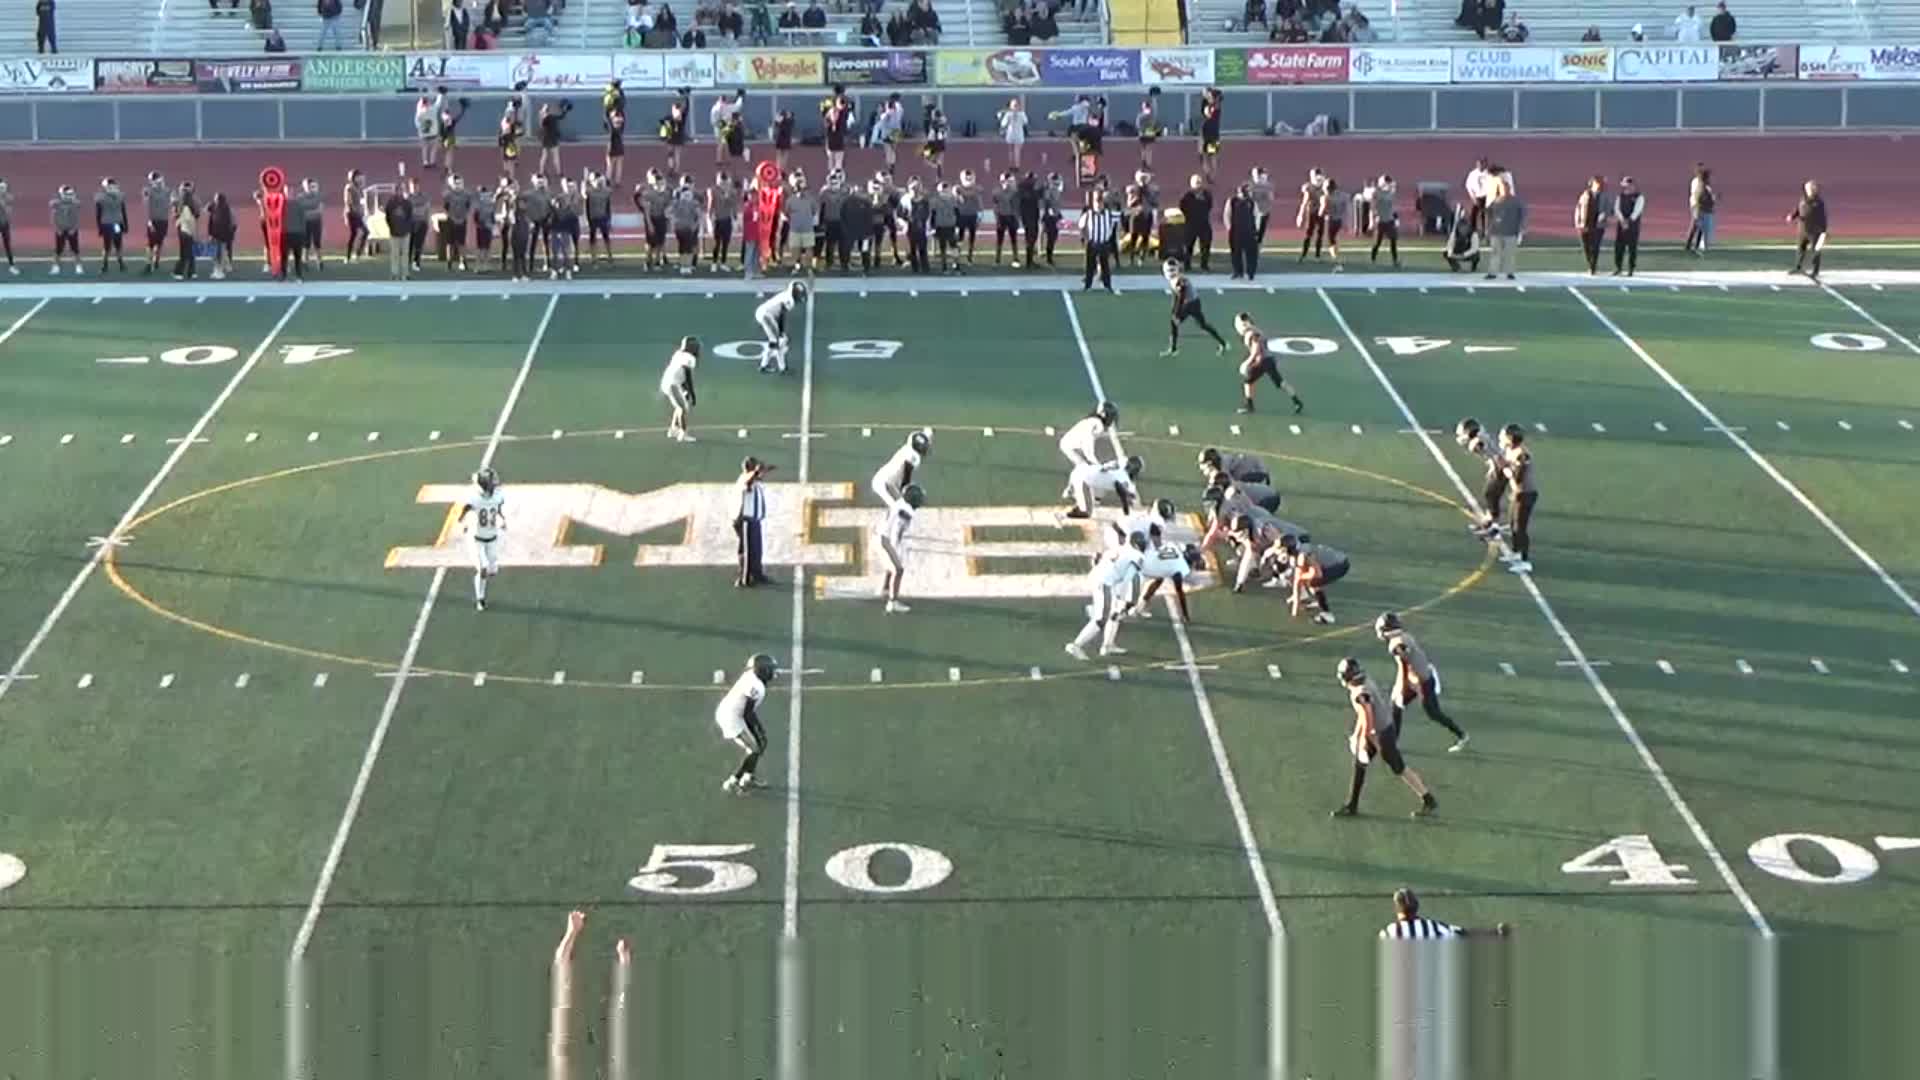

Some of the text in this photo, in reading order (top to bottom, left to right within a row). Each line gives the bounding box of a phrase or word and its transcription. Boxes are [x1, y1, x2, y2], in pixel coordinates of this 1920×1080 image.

[1049, 55, 1128, 67] South Atlantic
[1466, 51, 1512, 64] CLUB
[1561, 54, 1608, 66] SONIC
[305, 59, 401, 76] ANDERSON
[1459, 65, 1550, 78] WYNDHAM
[1100, 69, 1128, 80] Bank
